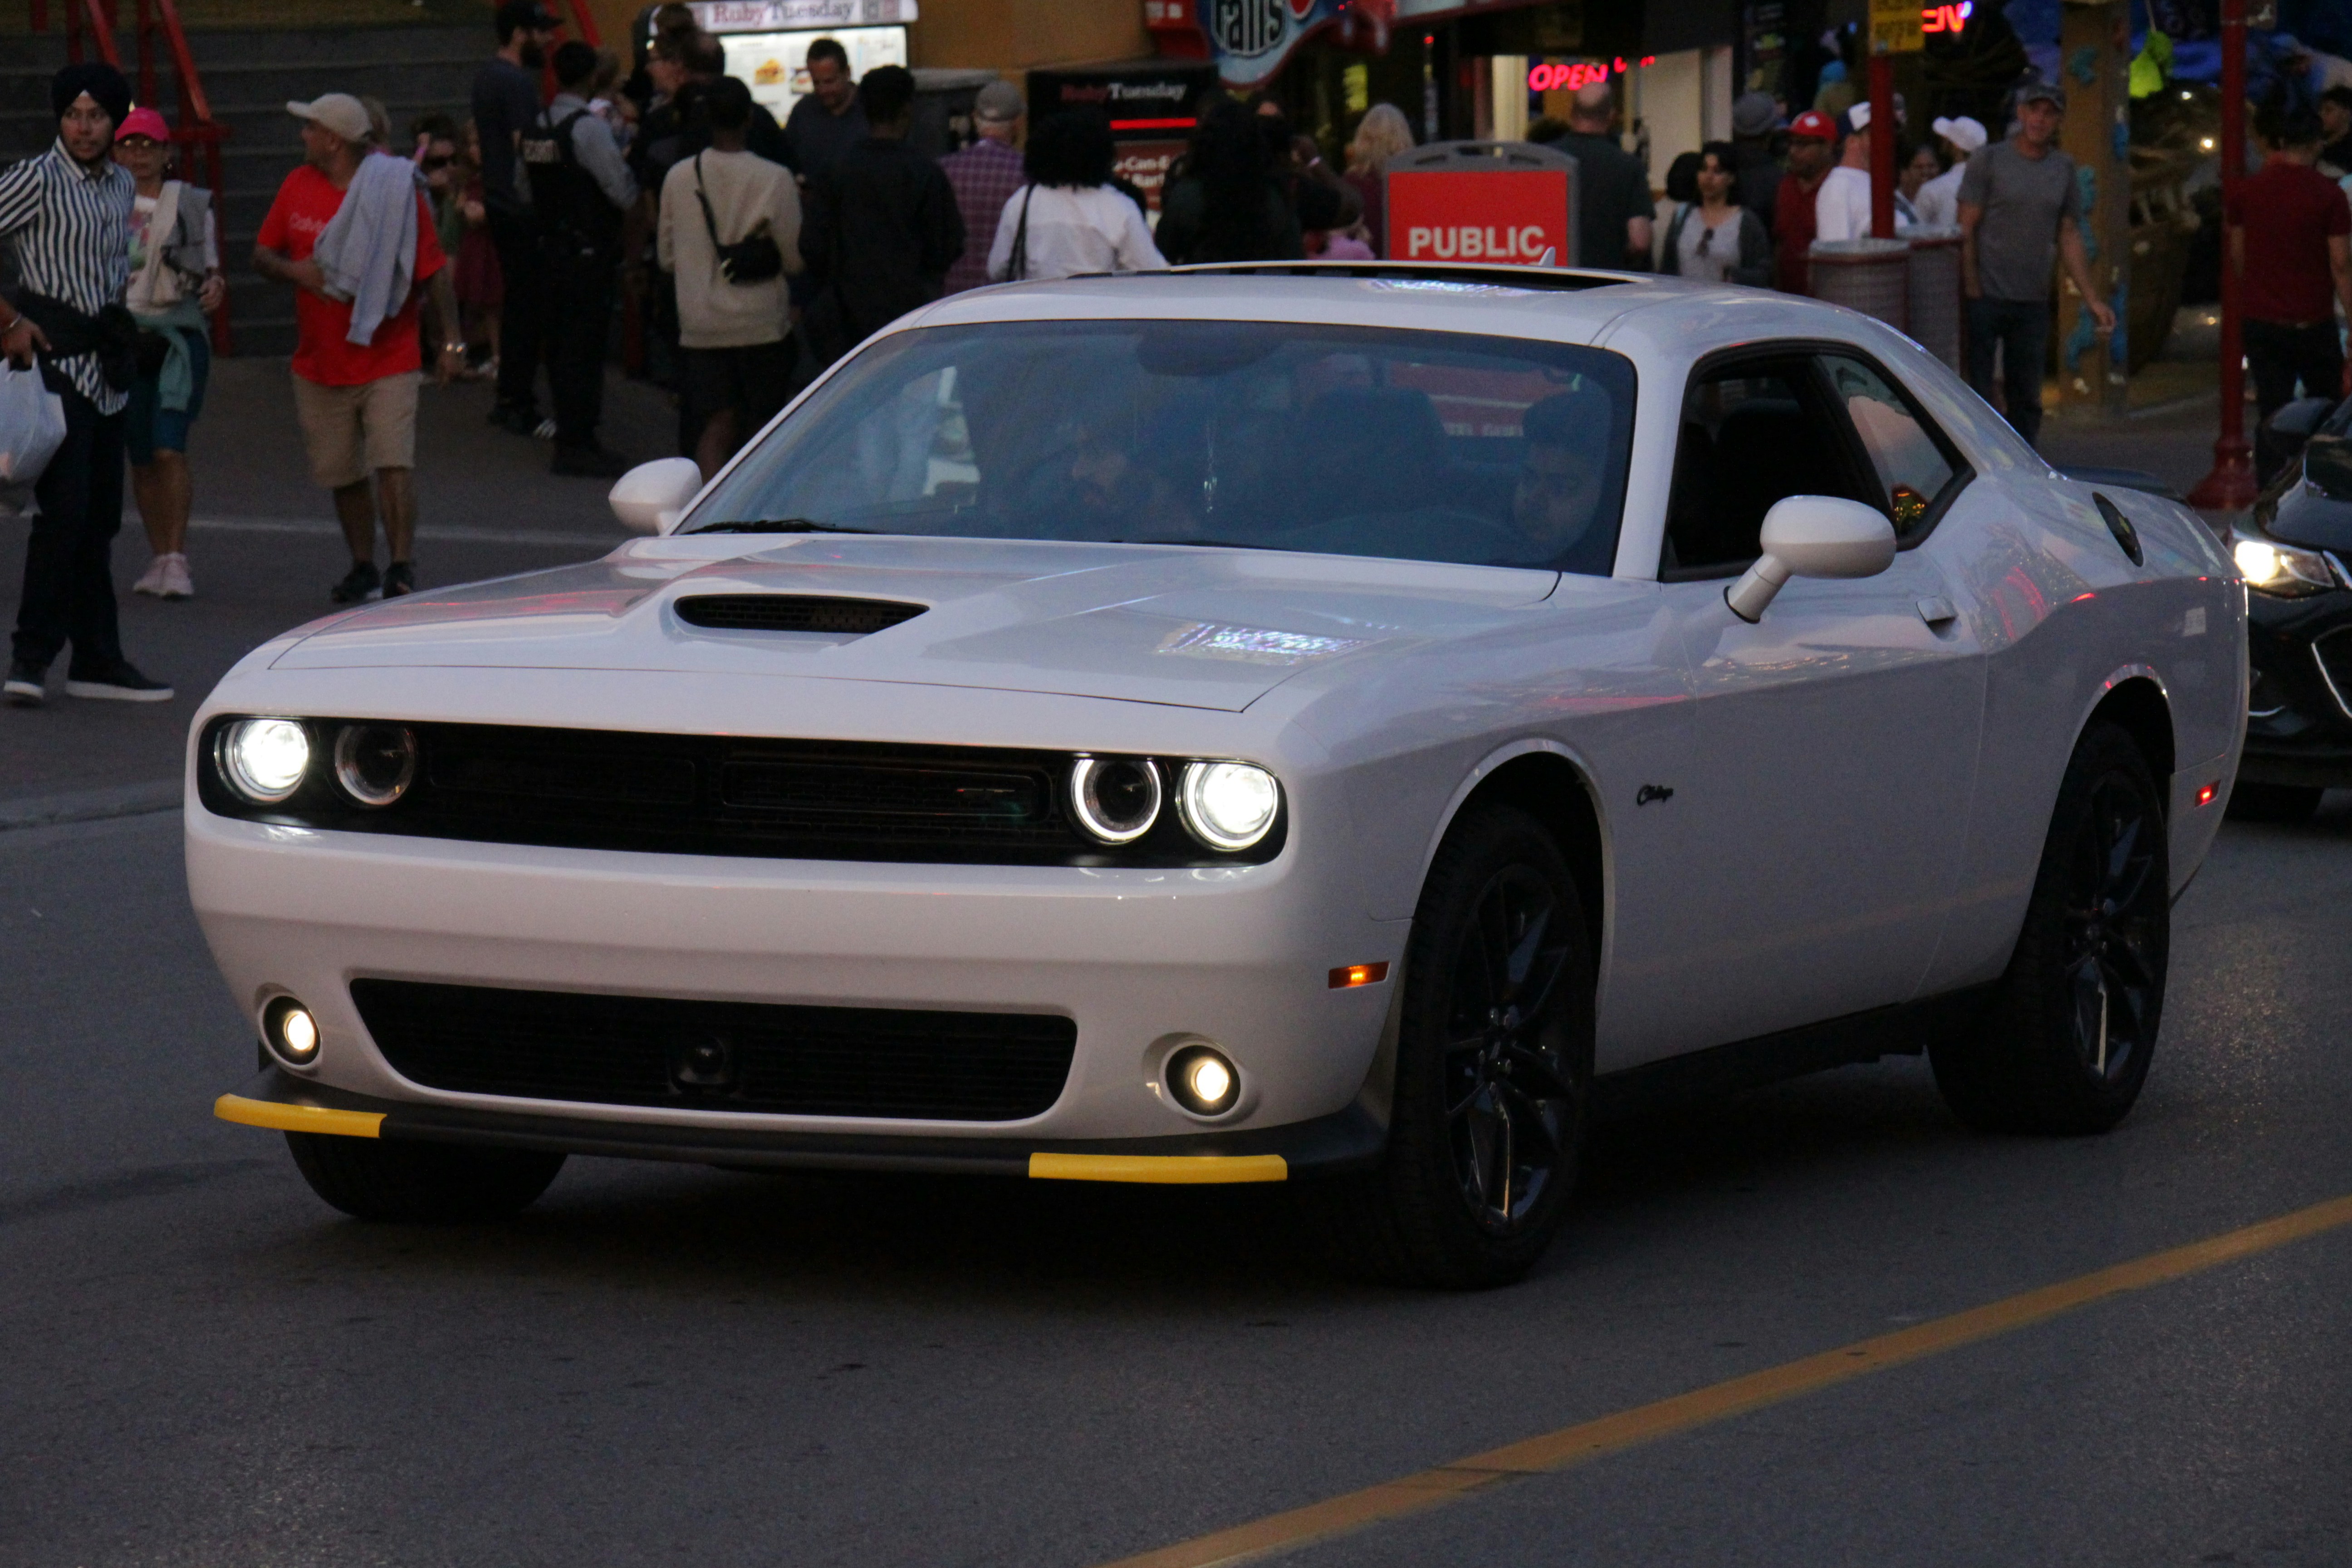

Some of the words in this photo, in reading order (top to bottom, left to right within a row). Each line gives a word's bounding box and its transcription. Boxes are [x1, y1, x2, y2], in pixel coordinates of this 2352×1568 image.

[713, 1, 768, 26] Ruby
[768, 0, 854, 21] Tuesday
[1528, 64, 1608, 91] OPEN
[1408, 225, 1545, 258] PUBLIC
